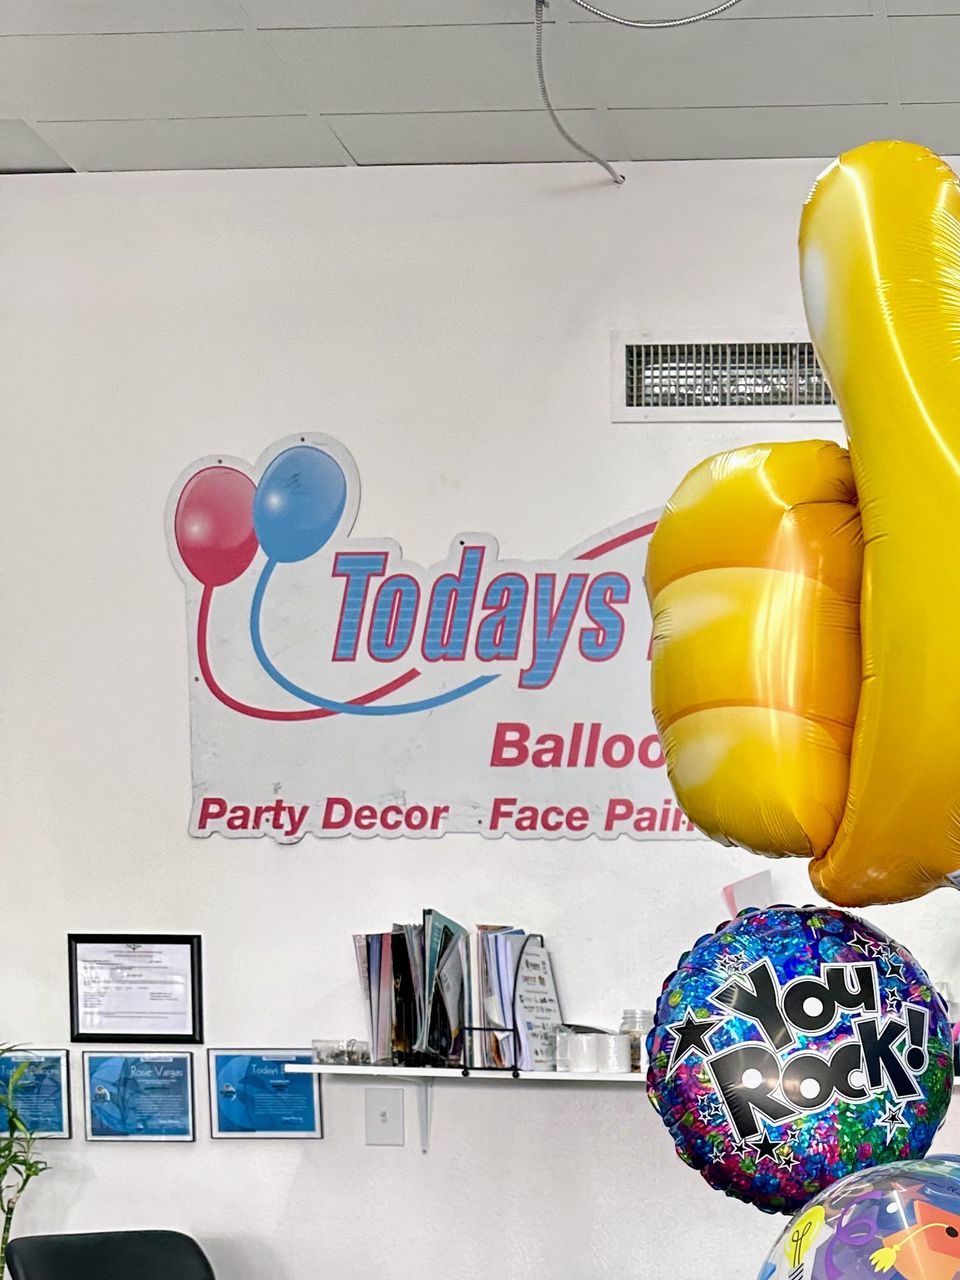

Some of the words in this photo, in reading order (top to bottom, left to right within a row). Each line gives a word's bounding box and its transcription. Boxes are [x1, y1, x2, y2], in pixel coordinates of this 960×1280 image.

[331, 546, 630, 689] Todays
[490, 722, 666, 769] Balloo
[199, 797, 309, 836] Party
[321, 797, 449, 831] Decor
[489, 797, 589, 831] Face
[604, 798, 695, 832] Pain
[708, 958, 879, 1052] You
